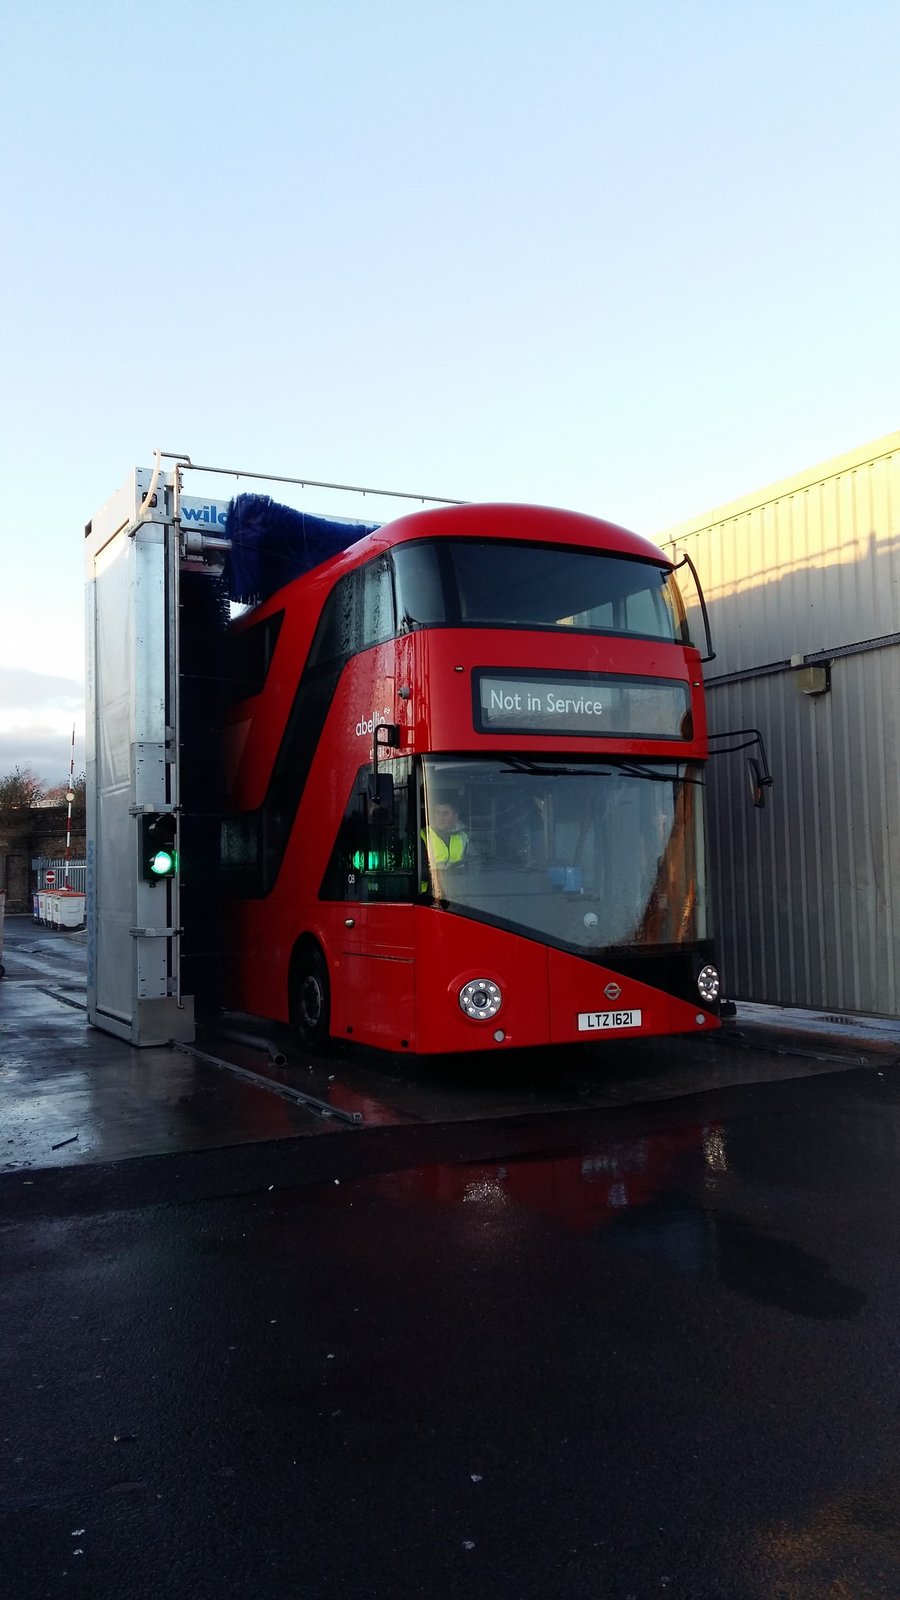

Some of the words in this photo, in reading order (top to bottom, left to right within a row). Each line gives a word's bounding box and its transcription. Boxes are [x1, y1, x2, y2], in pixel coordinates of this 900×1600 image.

[490, 689, 522, 711] Not
[527, 693, 542, 712] in
[546, 692, 603, 715] Service
[355, 711, 386, 737] abellio
[587, 1014, 610, 1028] LTZ
[612, 1011, 633, 1026] 1621
